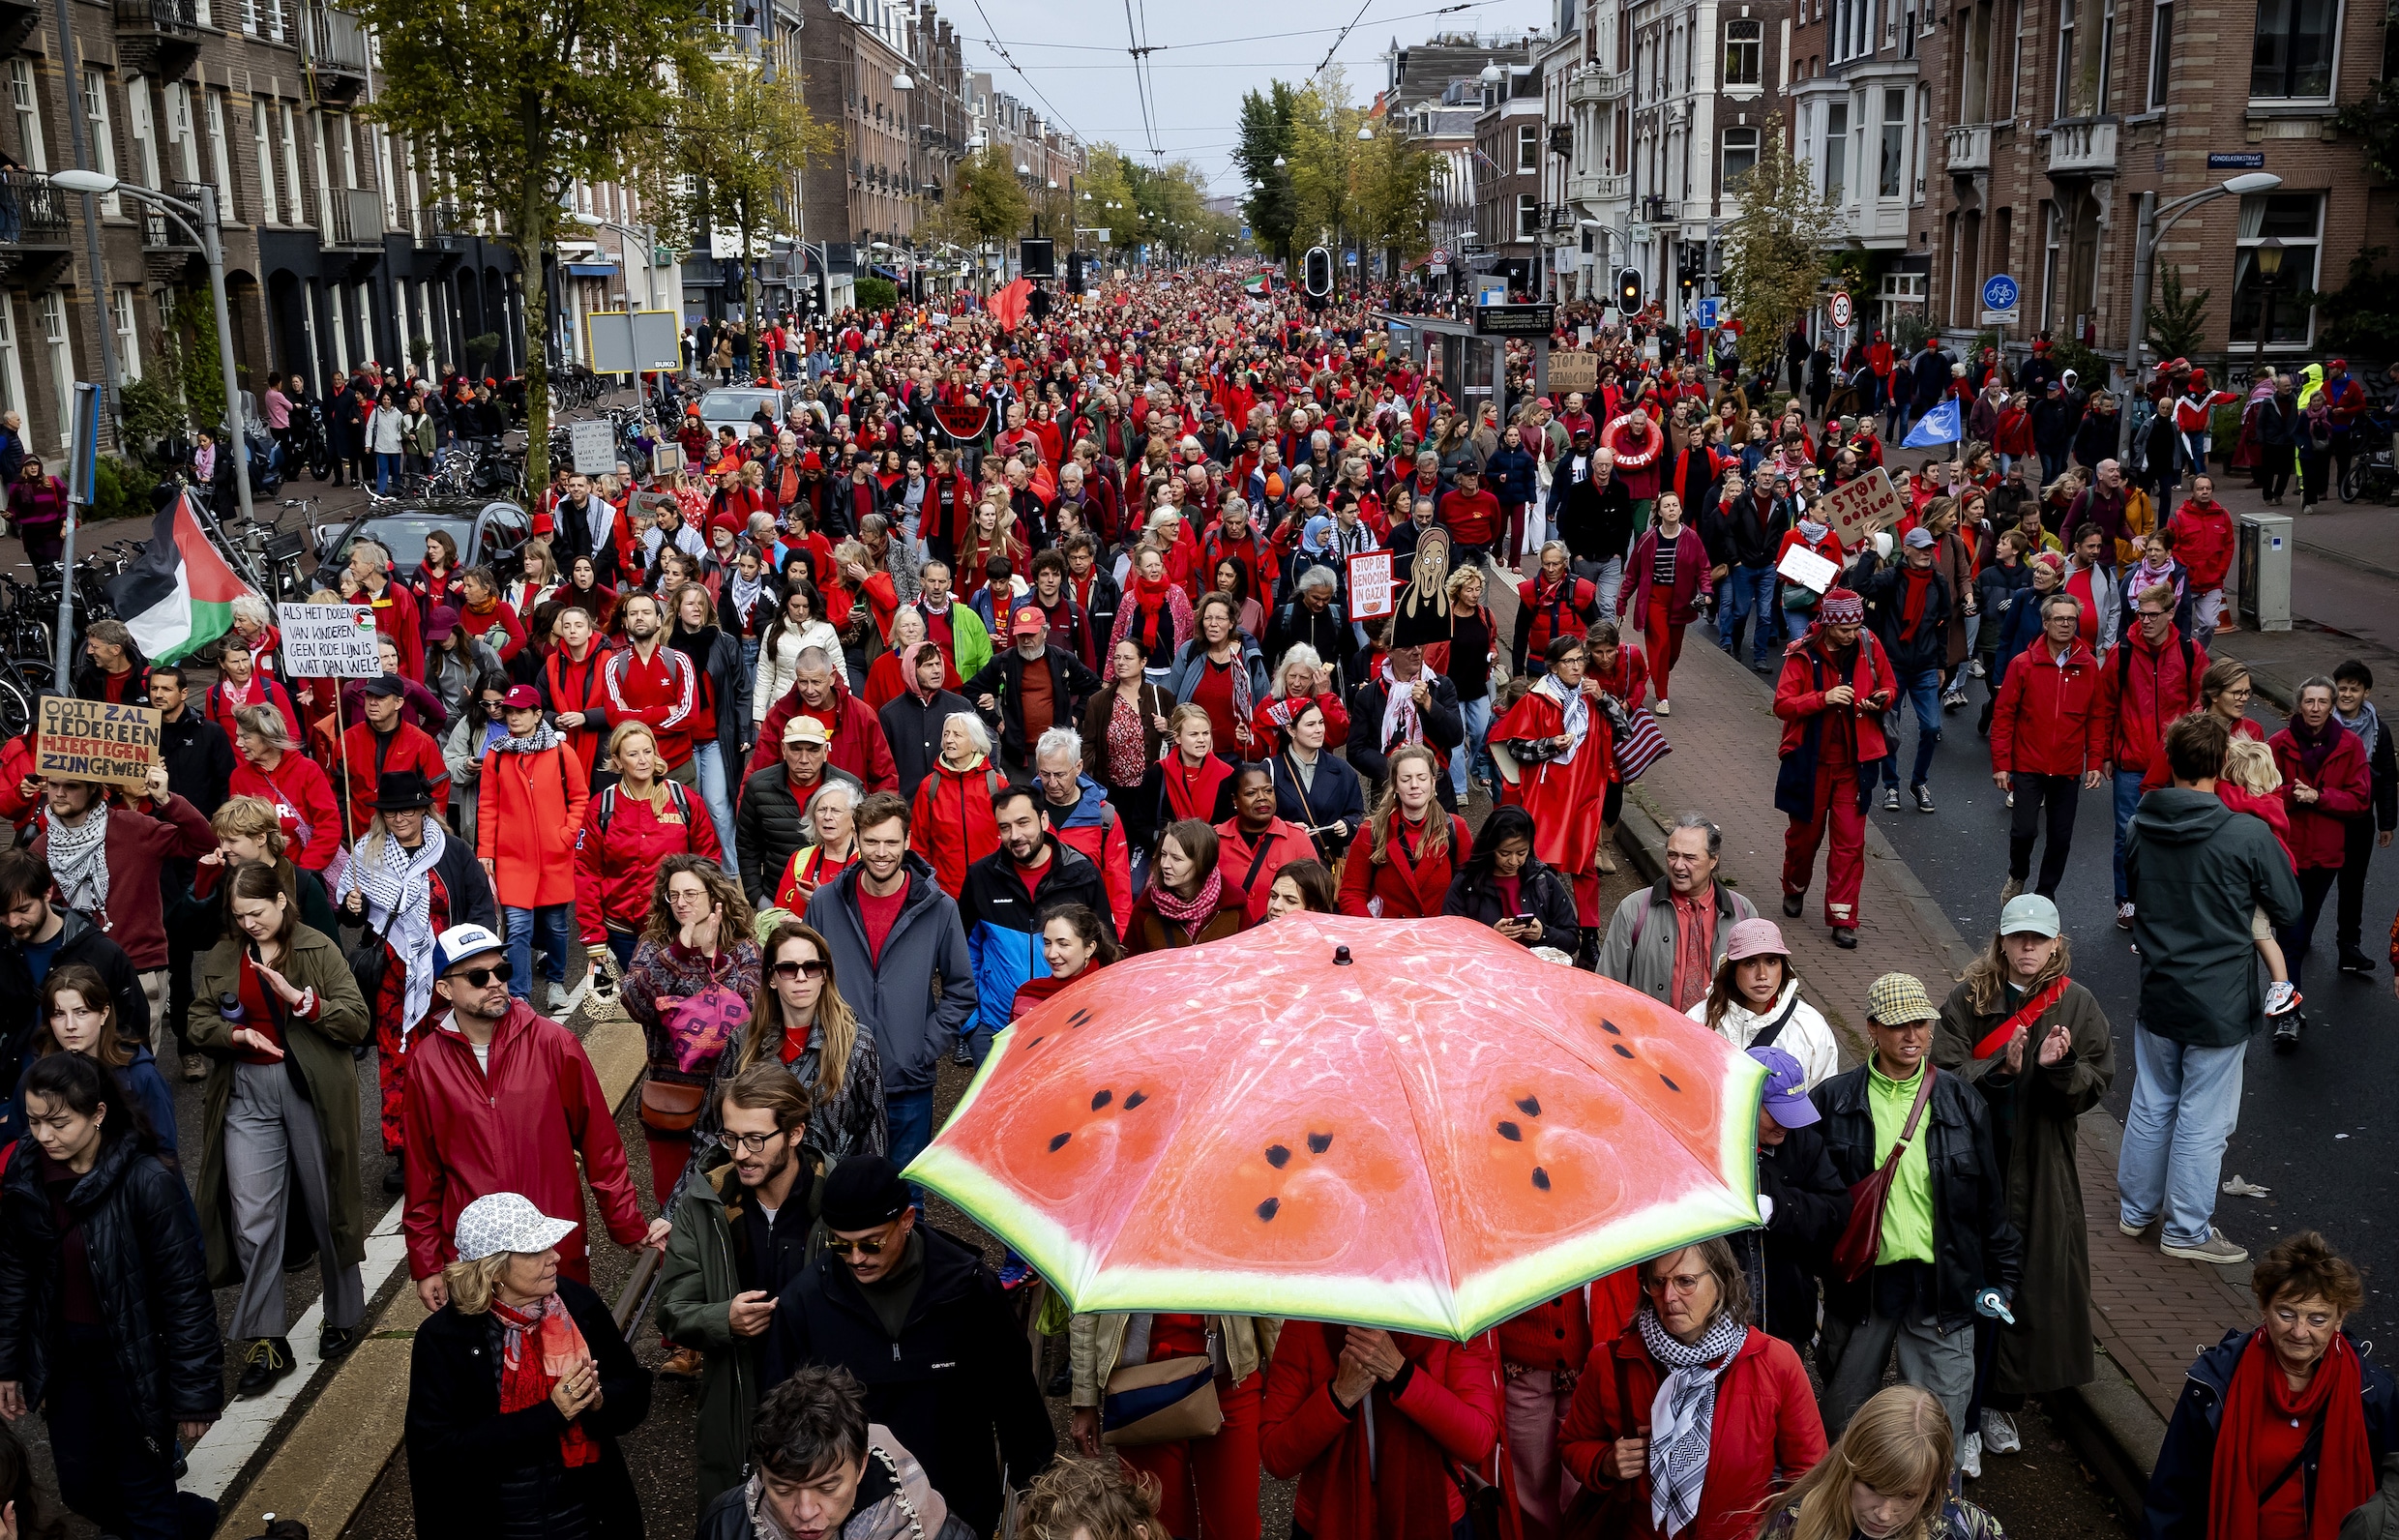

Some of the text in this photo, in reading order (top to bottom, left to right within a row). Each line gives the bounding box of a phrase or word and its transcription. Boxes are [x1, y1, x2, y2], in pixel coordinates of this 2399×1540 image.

[1548, 355, 1593, 370] STOP DE
[1548, 371, 1595, 384] GENOCIDE
[939, 406, 979, 416] JUSTICE
[950, 417, 979, 429] NOW
[1617, 452, 1651, 465] HELP!
[1831, 475, 1878, 514] STOP
[1842, 491, 1894, 526] OORLOG
[1355, 556, 1385, 572] STOP DE
[1353, 571, 1389, 587] GENOCIDE
[1356, 585, 1386, 602] IN GAZA!
[283, 606, 302, 619] ALS
[305, 607, 322, 620] HET
[288, 626, 309, 639] VAN
[290, 643, 315, 657] GEEN
[319, 642, 340, 656] RODE
[294, 656, 380, 674] WAT DAN WEL?
[509, 688, 519, 697] P
[44, 699, 149, 725] OOIT ZAL
[45, 716, 159, 747] IEDEREEN
[42, 735, 149, 763] HIERTEGEN
[90, 757, 151, 779] GEWEES
[1835, 1271, 1848, 1284] 30
